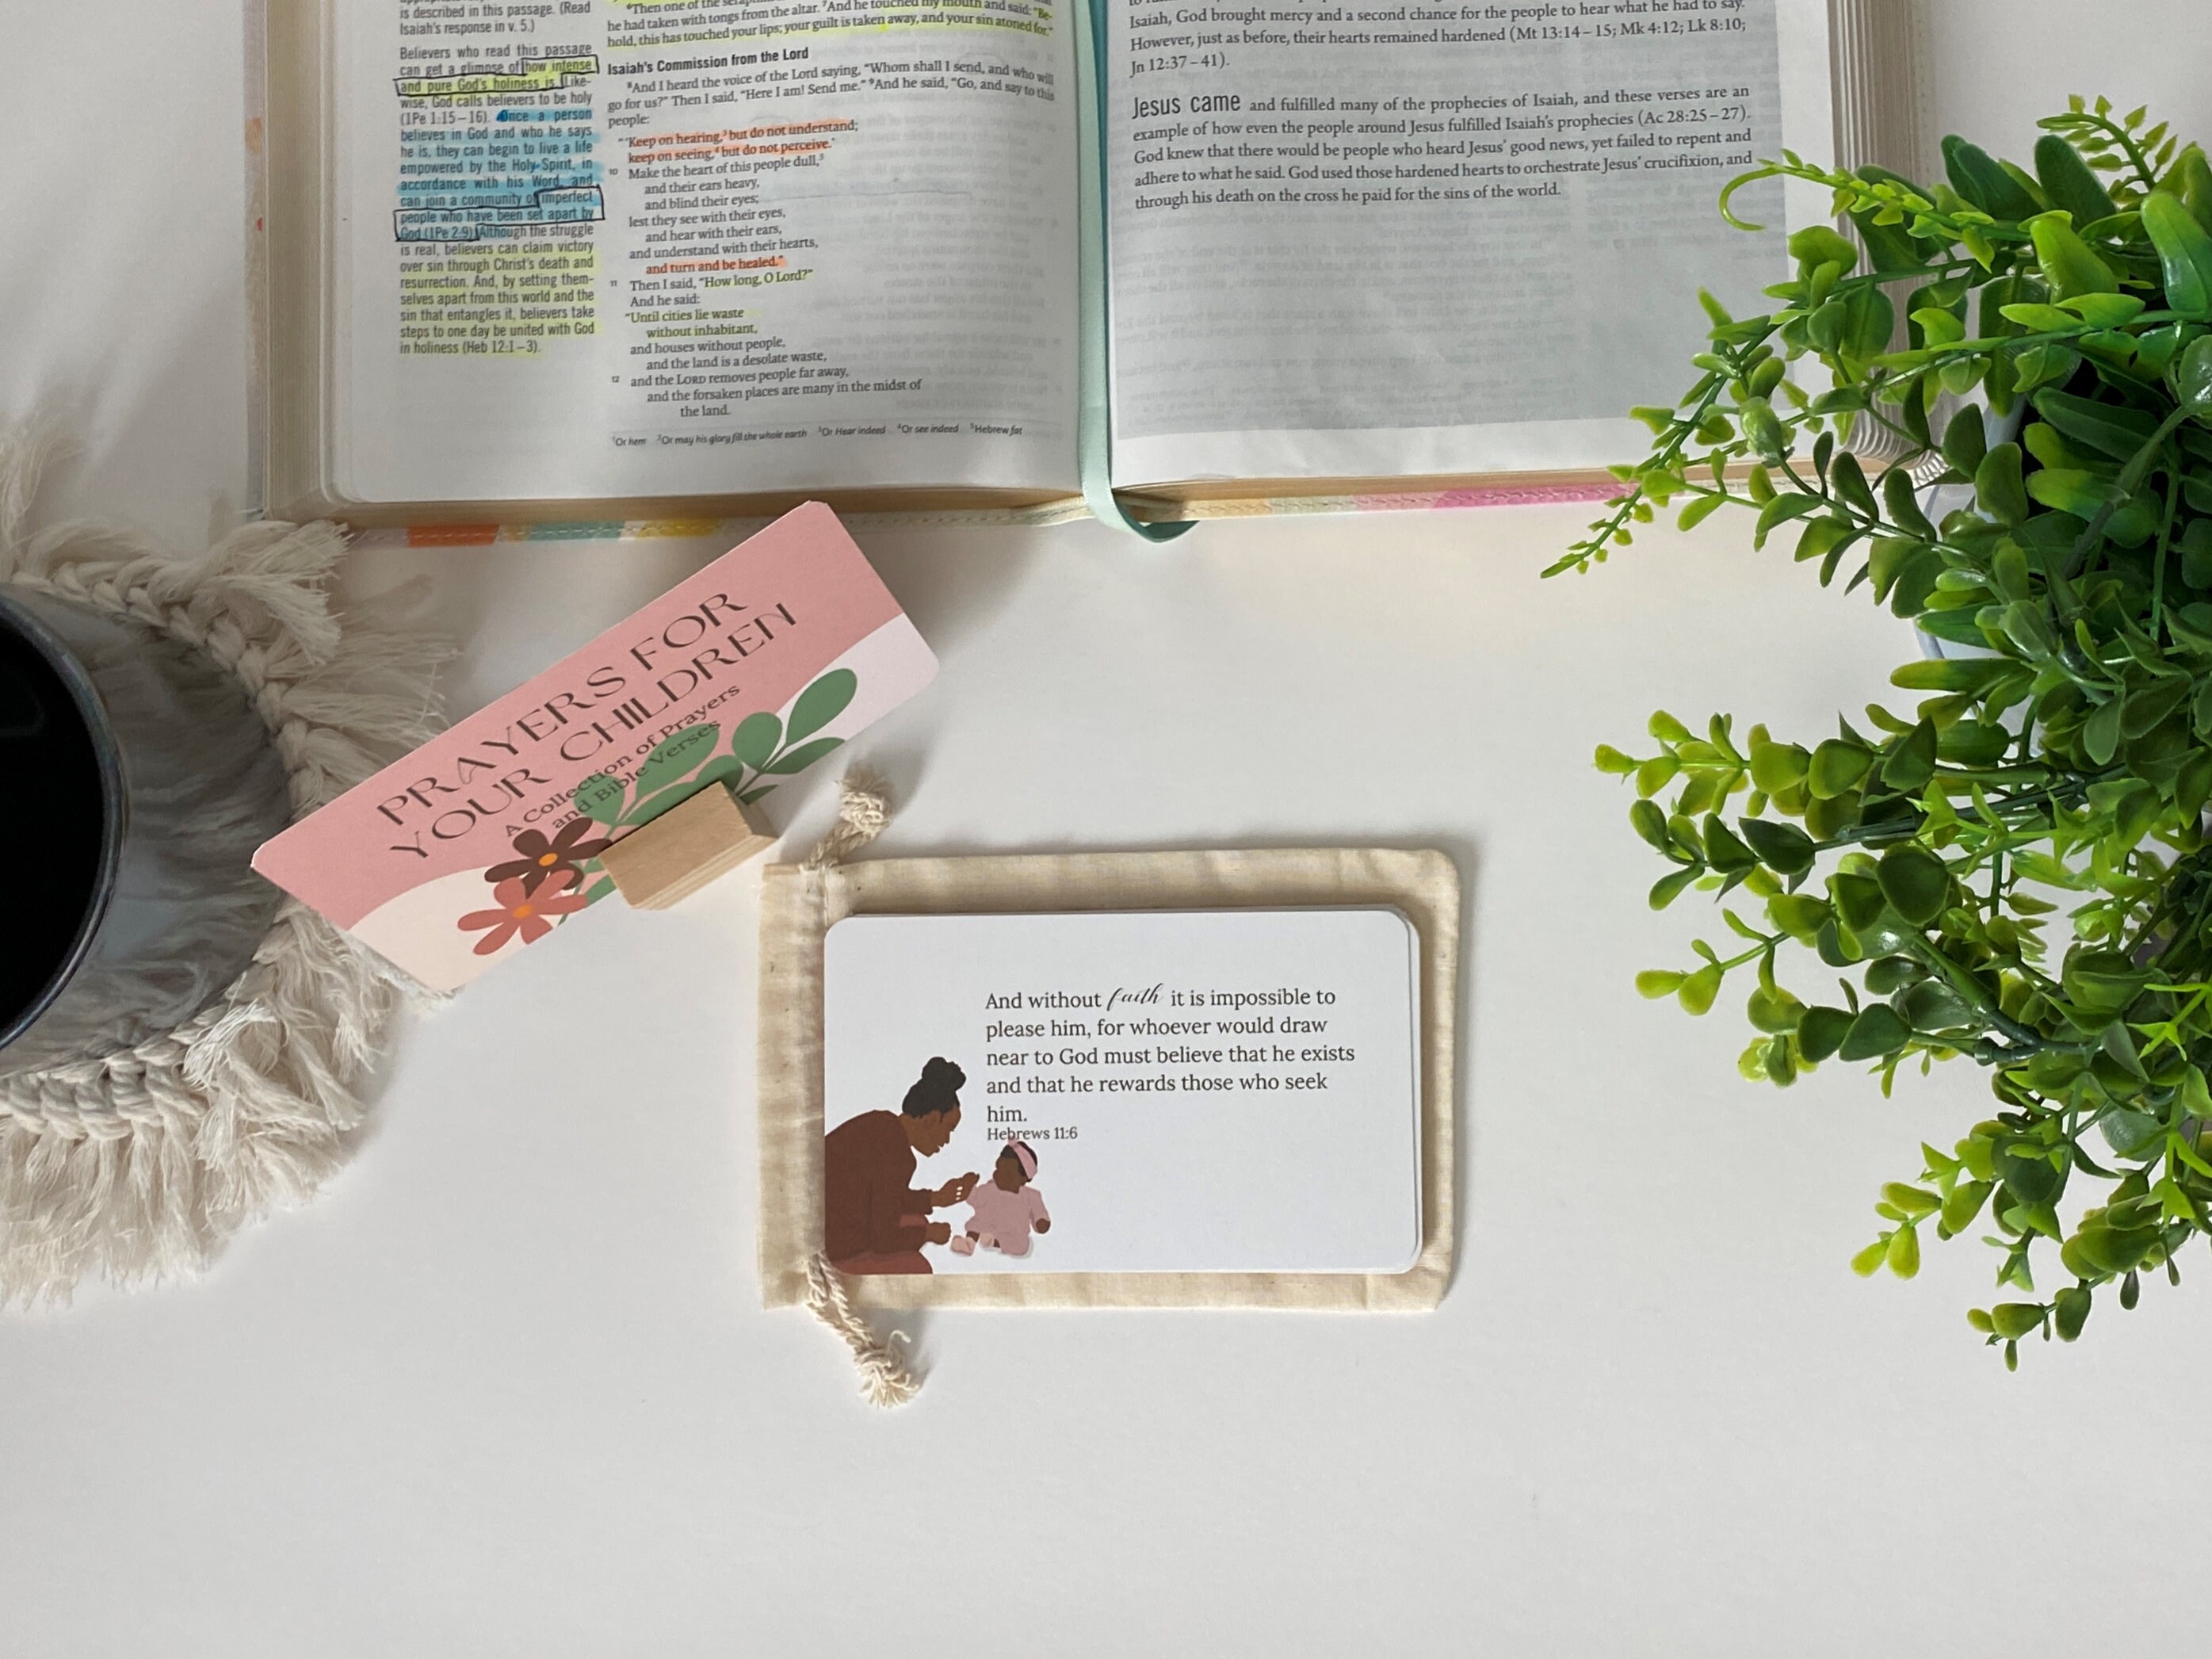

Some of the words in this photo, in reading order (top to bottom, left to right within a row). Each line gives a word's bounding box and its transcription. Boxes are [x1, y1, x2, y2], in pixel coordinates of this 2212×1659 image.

[1131, 36, 1194, 52] However,
[1198, 32, 1222, 48] just
[1243, 30, 1289, 46] before,
[1293, 30, 1326, 43] their
[1329, 30, 1370, 44] hearts
[1374, 29, 1438, 43] remained
[1442, 27, 1505, 42] hardened
[1510, 26, 1537, 43] (Mt
[1621, 21, 1645, 35] Mk
[1648, 21, 1683, 35] 4:12;
[1688, 19, 1706, 32] Lk
[1710, 18, 1745, 32] 8:10;
[657, 56, 728, 71] Commission
[732, 54, 757, 66] from
[761, 51, 778, 63] the
[783, 47, 808, 60] Lord
[1129, 61, 1144, 78] Jn
[1132, 97, 1180, 119] Jesus
[1190, 94, 1240, 113] came
[1250, 97, 1275, 111] and
[1281, 97, 1335, 110] fulfilled
[1341, 102, 1378, 115] many
[1383, 97, 1399, 110] of
[1404, 97, 1425, 110] the
[1431, 95, 1507, 114] prophecies
[1512, 94, 1528, 107] of
[1534, 92, 1578, 107] Isaiah,
[1584, 90, 1609, 104] and
[1615, 90, 1652, 102] these
[1657, 90, 1700, 100] verses
[1706, 89, 1727, 97] are
[1733, 88, 1749, 97] an
[1133, 123, 1188, 142] example
[1193, 121, 1209, 135] of
[1212, 121, 1243, 134] how
[1282, 120, 1303, 133] the
[1308, 120, 1354, 138] people
[1358, 120, 1405, 133] around
[1408, 120, 1444, 136] Jesus
[1449, 117, 1501, 132] fulfilled
[1557, 113, 1633, 132] prophecies
[1638, 109, 1664, 127] (Ac
[1136, 191, 1189, 209] through
[1192, 190, 1212, 203] his
[1216, 189, 1254, 202] death
[1279, 188, 1301, 201] the
[1305, 193, 1339, 201] cross
[1342, 188, 1358, 201] he
[1362, 188, 1392, 205] paid
[1395, 187, 1415, 201] for
[1419, 186, 1440, 200] the
[1444, 188, 1469, 199] sins
[1473, 185, 1488, 198] of
[1492, 184, 1513, 197] the
[1517, 182, 1561, 196] world.
[629, 247, 651, 259] and
[654, 243, 719, 258] understand
[722, 242, 747, 254] with
[751, 239, 777, 252] their
[779, 239, 818, 249] hearts,
[400, 262, 423, 272] over
[427, 262, 443, 272] sin
[448, 258, 489, 273] through
[539, 257, 569, 269] death
[574, 255, 593, 269] and
[630, 280, 660, 291] Then
[663, 279, 667, 289] I
[670, 277, 697, 289] said,
[734, 275, 762, 287] long,
[764, 273, 774, 283] O
[663, 310, 692, 321] cities
[695, 309, 709, 319] lie
[712, 310, 744, 319] waste
[400, 326, 429, 340] steps
[434, 325, 444, 337] to
[448, 327, 466, 337] one
[471, 324, 490, 339] day
[494, 324, 506, 336] be
[510, 323, 544, 336] united
[548, 323, 570, 334] with
[575, 322, 594, 334] God
[646, 327, 691, 338] without
[694, 324, 758, 336] inhabitant,
[630, 343, 651, 355] and
[655, 342, 694, 354] houses
[697, 340, 743, 351] without
[746, 336, 785, 353] people,
[696, 434, 707, 443] his
[709, 434, 731, 445] glory
[729, 433, 743, 444] fill
[743, 432, 758, 441] the
[758, 430, 783, 439] whole
[785, 430, 807, 438] earth
[376, 664, 626, 828] PRAYERS
[631, 591, 749, 671] FOR
[388, 767, 548, 859] YOUR
[558, 602, 797, 765] CHILDREN
[504, 821, 524, 838] A
[523, 753, 632, 828] Collection
[635, 736, 661, 759] of
[659, 684, 742, 740] Prayers
[551, 801, 595, 831] and
[592, 765, 648, 805] Bible
[648, 717, 721, 769] Verses
[985, 992, 1022, 1009] And
[1028, 992, 1102, 1008] without
[1106, 983, 1163, 1011] faith
[1171, 990, 1185, 1006] it
[1190, 990, 1205, 1006] is
[1211, 988, 1310, 1010] impossible
[1316, 990, 1335, 1004] to
[987, 1020, 1045, 1042] please
[1051, 1019, 1091, 1038] him,
[1098, 1019, 1125, 1035] for
[1129, 1019, 1211, 1034] whoever
[1217, 1017, 1274, 1034] would
[1280, 1016, 1328, 1033] draw
[988, 1053, 1029, 1065] near
[1034, 1051, 1053, 1065] to
[1060, 1047, 1098, 1065] God
[1105, 1049, 1152, 1064] must
[1157, 1046, 1222, 1063] believe
[1228, 1045, 1267, 1062] that
[1273, 1045, 1295, 1061] he
[1301, 1045, 1354, 1061] exists
[987, 1076, 1021, 1094] and
[1027, 1076, 1065, 1093] that
[1071, 1076, 1093, 1092] he
[1099, 1074, 1175, 1091] rewards
[1182, 1074, 1233, 1091] those
[1240, 1073, 1279, 1090] who
[1286, 1072, 1328, 1089] seek
[988, 1106, 1027, 1122] him.
[988, 1127, 1050, 1141] Hebrews
[1054, 1126, 1078, 1139] 11:6
